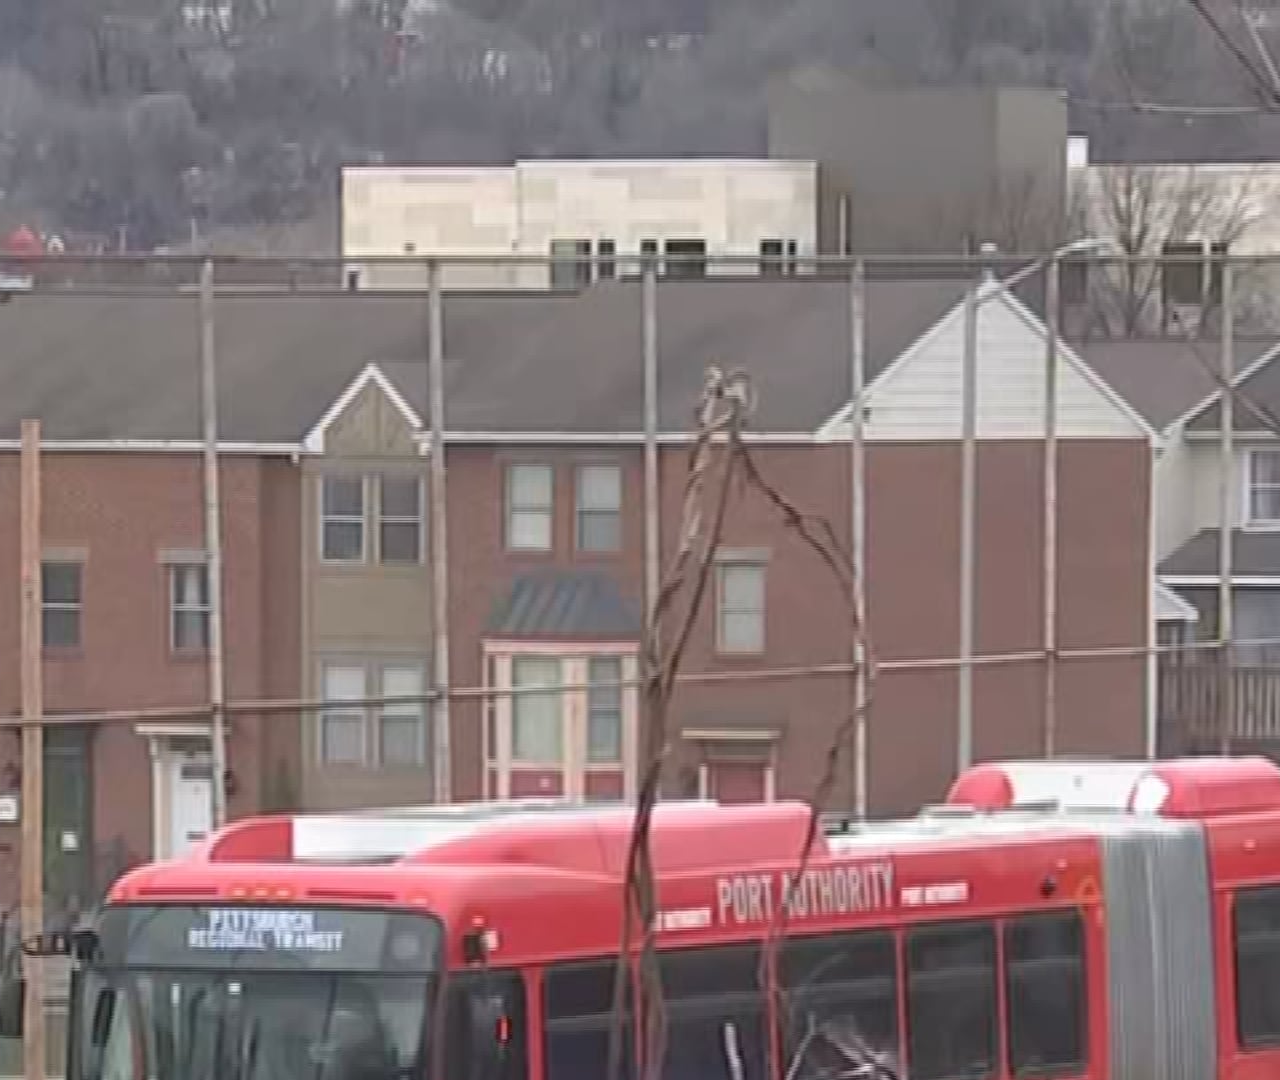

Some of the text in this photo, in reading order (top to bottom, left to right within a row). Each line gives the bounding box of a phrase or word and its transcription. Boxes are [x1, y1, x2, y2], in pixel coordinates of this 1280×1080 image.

[716, 861, 894, 927] PORT AUTHORITY
[271, 931, 343, 951] TRANSIT
